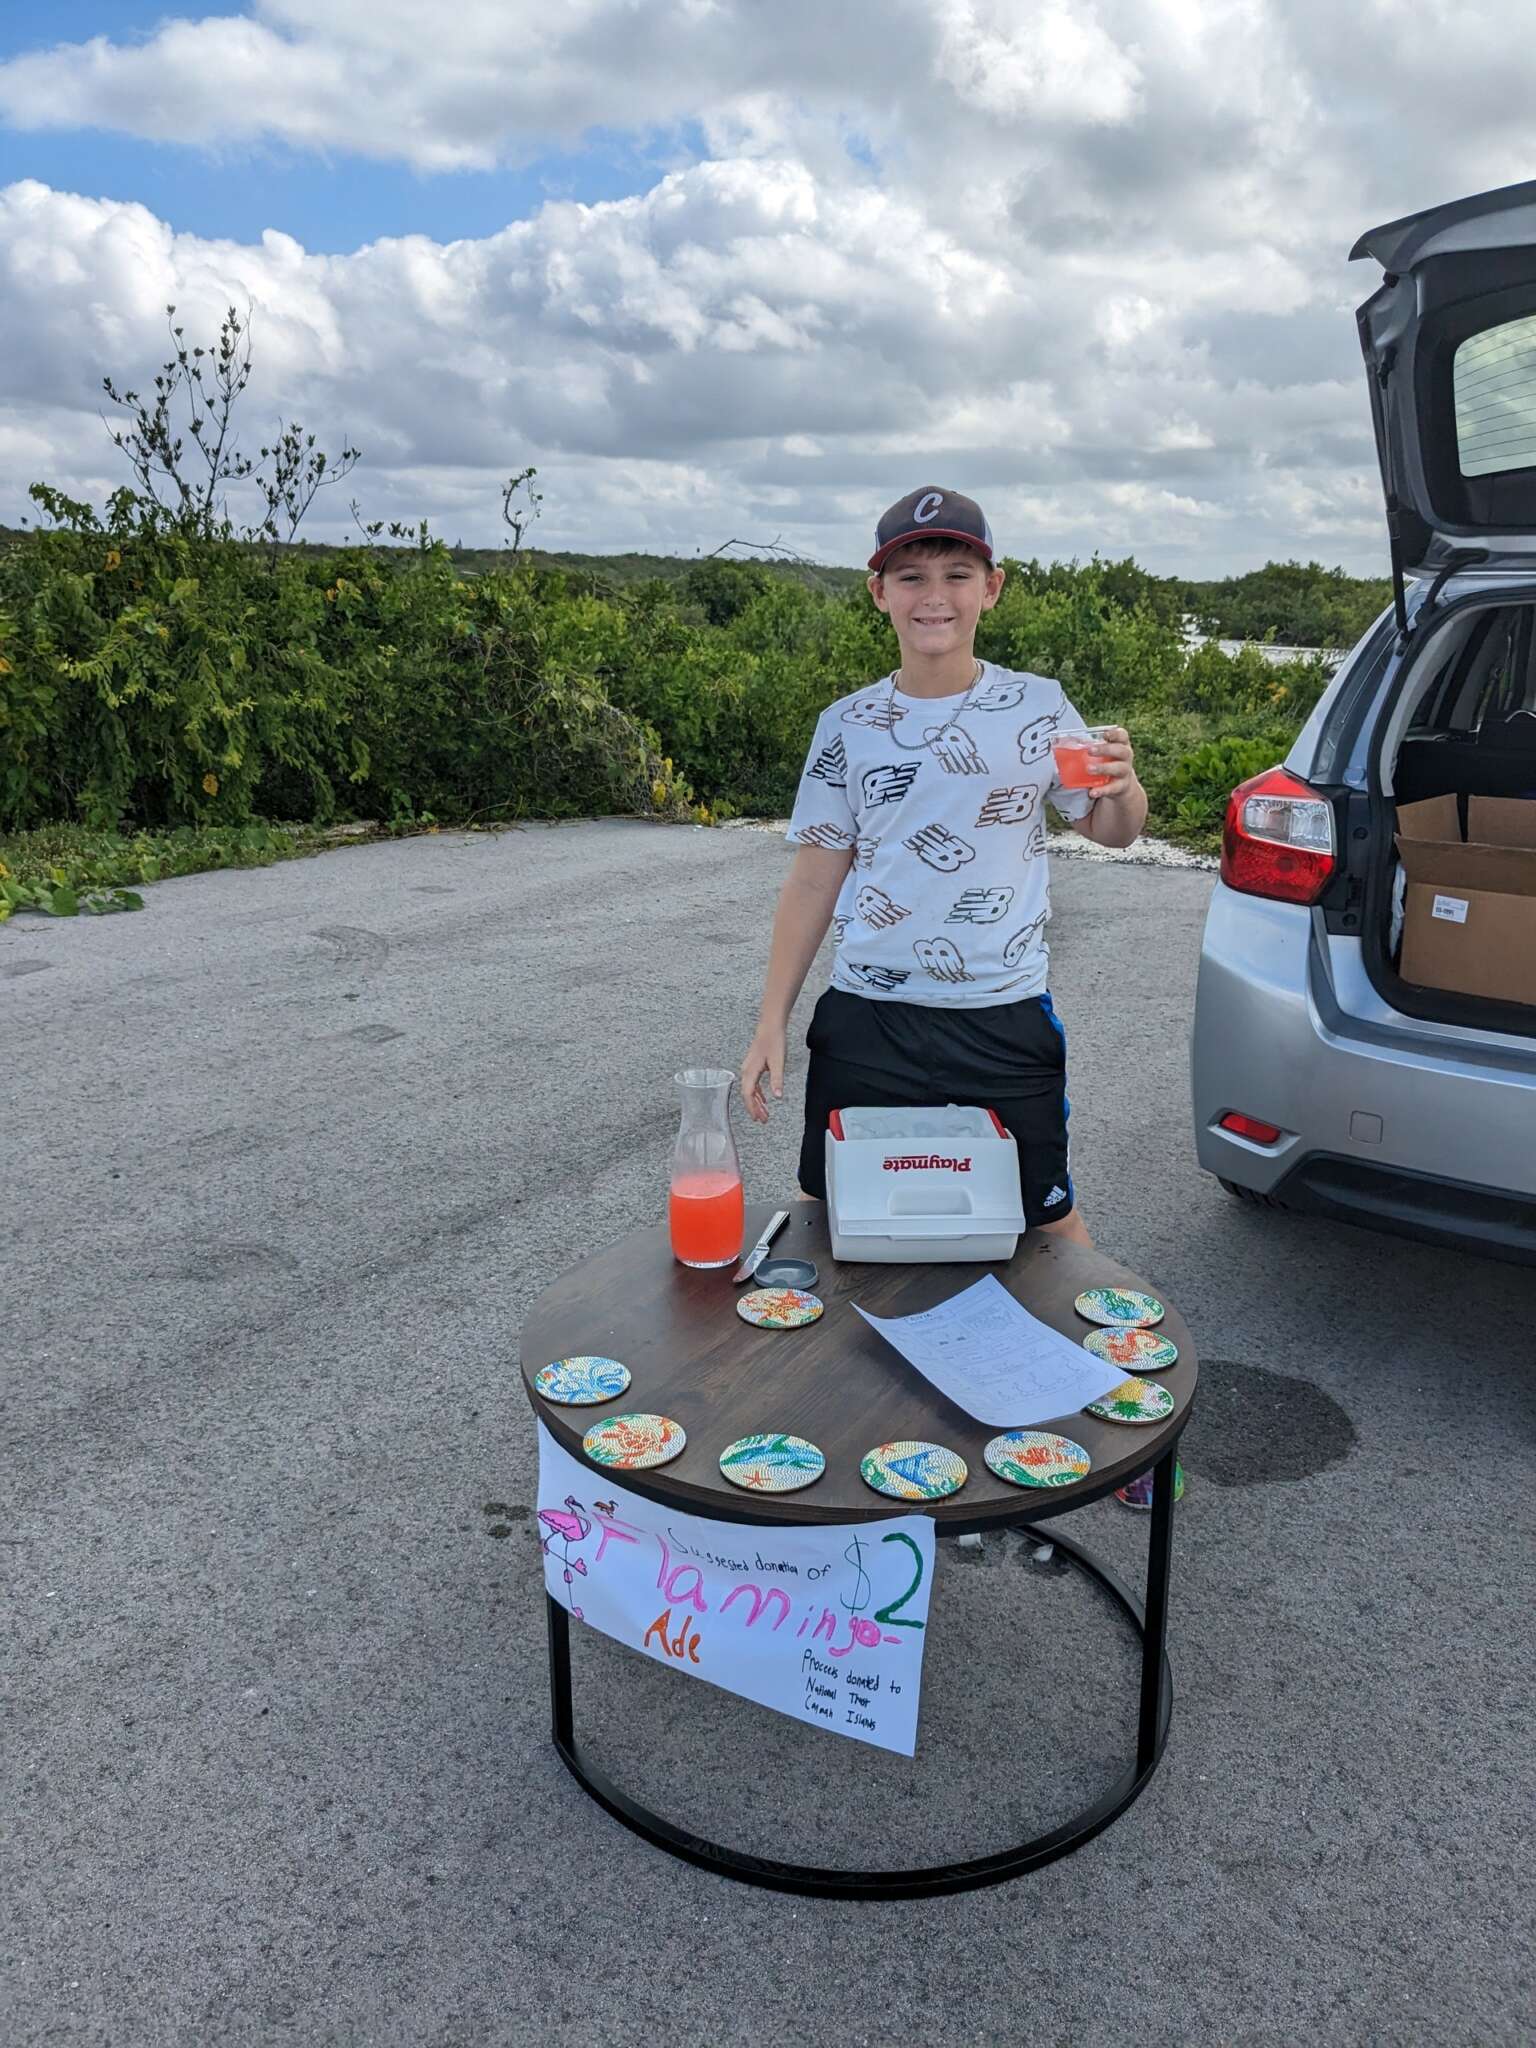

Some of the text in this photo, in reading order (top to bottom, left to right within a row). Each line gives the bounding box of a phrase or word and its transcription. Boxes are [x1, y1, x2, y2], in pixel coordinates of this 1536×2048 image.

[913, 492, 943, 523] C
[974, 784, 1039, 828] NB
[943, 886, 1015, 924] NB
[882, 1154, 972, 1172] Playmate
[756, 1551, 799, 1576] donation
[644, 1608, 701, 1664] Ade
[805, 1675, 837, 1700] National
[846, 1670, 880, 1692] donated
[889, 1680, 902, 1695] to
[846, 1709, 877, 1732] Islands
